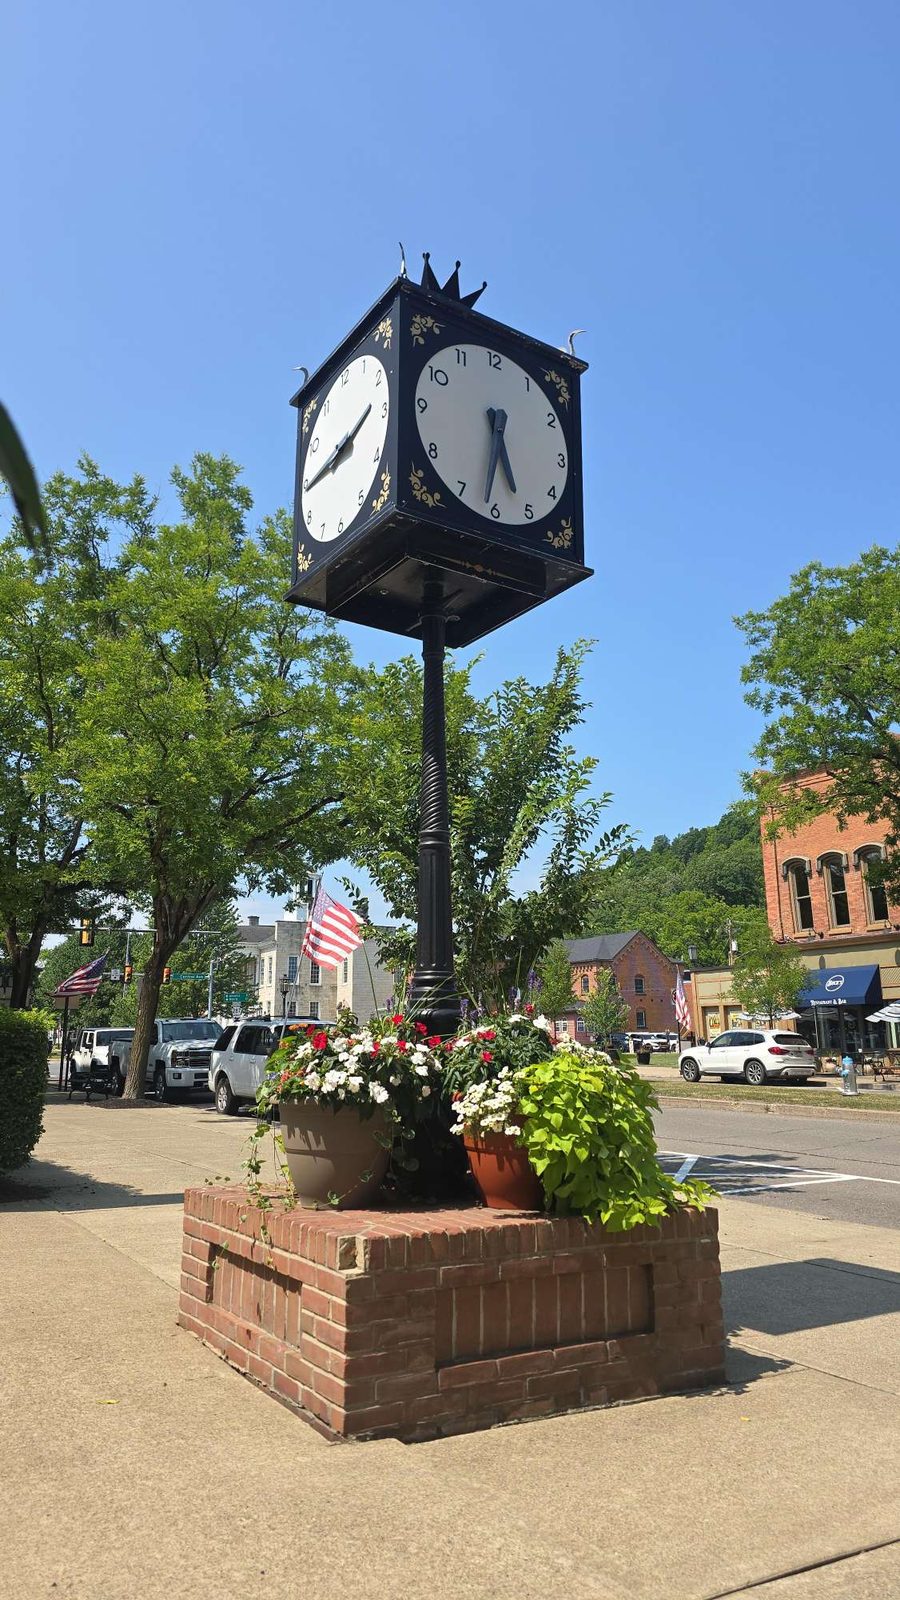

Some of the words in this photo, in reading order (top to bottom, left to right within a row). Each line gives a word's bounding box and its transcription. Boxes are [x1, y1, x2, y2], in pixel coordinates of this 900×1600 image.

[456, 349, 466, 366] 11
[487, 351, 502, 370] 12
[362, 360, 366, 374] 1
[341, 369, 349, 388] 12
[376, 369, 382, 387] 2
[428, 366, 448, 386] 10
[525, 377, 530, 392] 1
[323, 404, 330, 416] 11
[382, 402, 387, 419] 3
[417, 398, 428, 413] 9
[547, 413, 556, 428] 2
[309, 437, 320, 455] 10
[428, 442, 438, 459] 8
[373, 446, 380, 463] 4
[557, 453, 566, 468] 3
[457, 480, 466, 497] 7
[547, 485, 557, 500] 4
[357, 490, 364, 506] 5
[307, 510, 312, 525] 8
[490, 504, 500, 519] 6
[524, 504, 534, 519] 5
[321, 523, 326, 539] 7
[338, 517, 344, 533] 6
